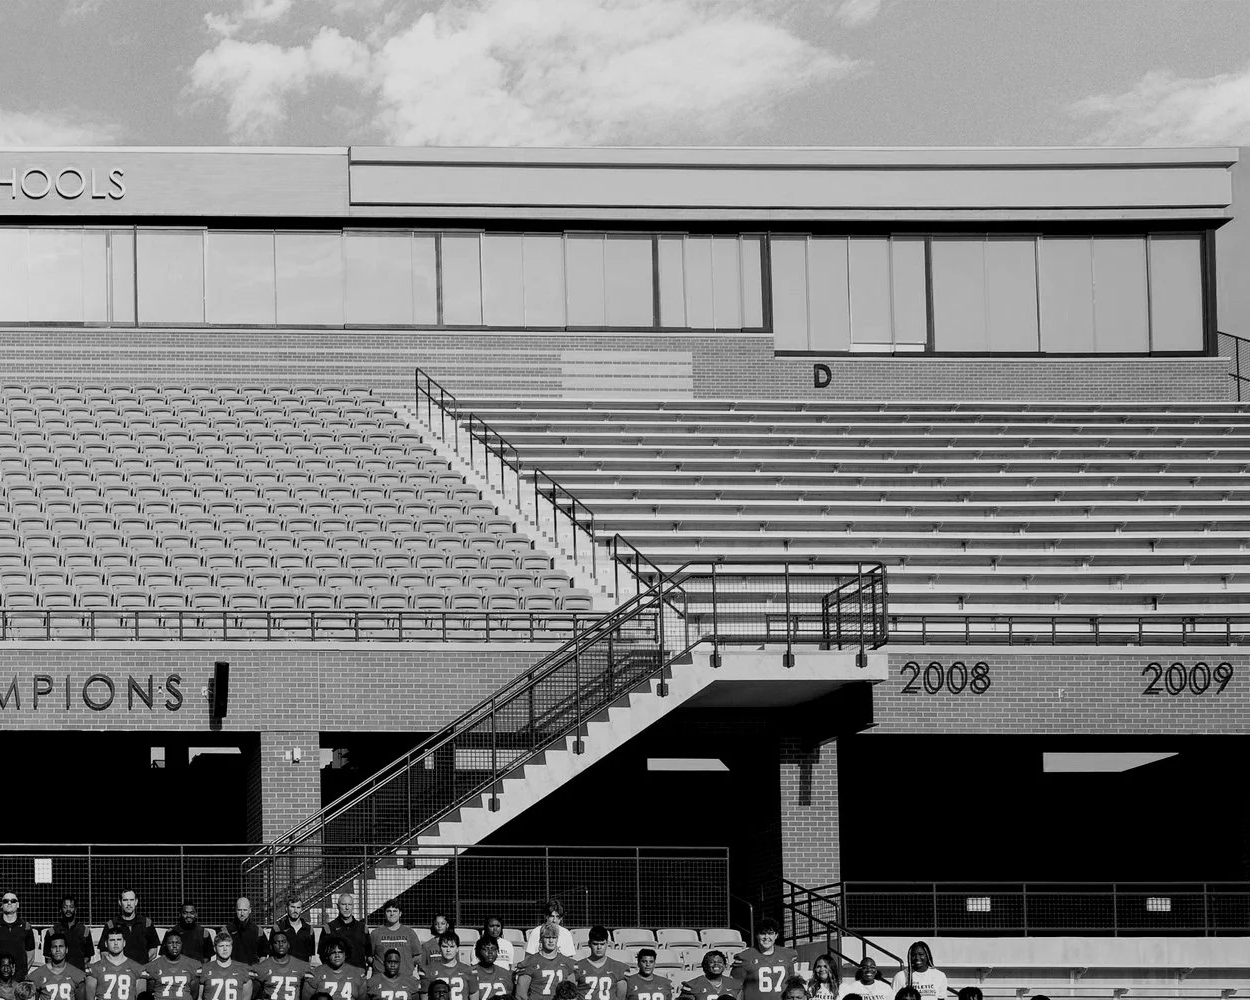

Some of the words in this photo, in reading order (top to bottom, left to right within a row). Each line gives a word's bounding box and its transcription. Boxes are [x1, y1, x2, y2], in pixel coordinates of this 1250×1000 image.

[813, 364, 832, 388] D
[900, 661, 991, 695] 2008
[1141, 662, 1234, 696] 2009
[104, 974, 130, 1000] 78
[161, 976, 187, 997] 77
[271, 976, 297, 1000] 75
[542, 970, 563, 994] 71
[759, 966, 785, 992] 67
